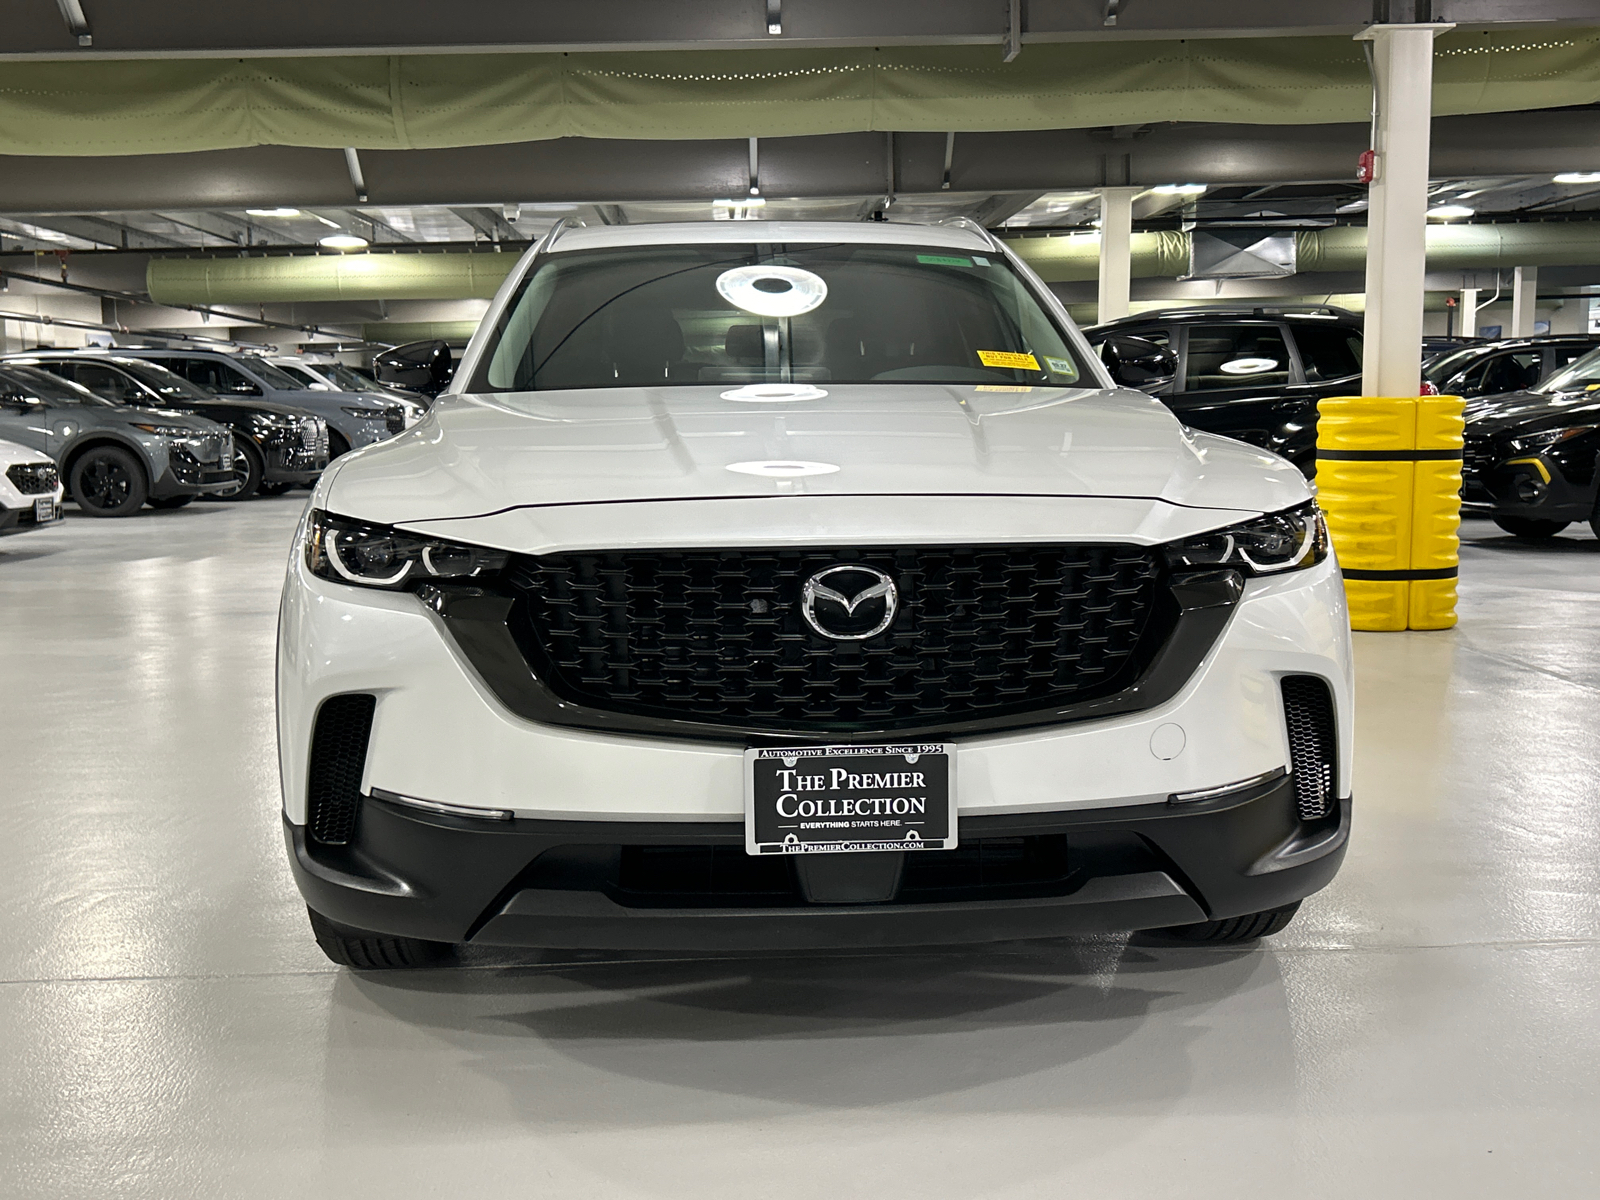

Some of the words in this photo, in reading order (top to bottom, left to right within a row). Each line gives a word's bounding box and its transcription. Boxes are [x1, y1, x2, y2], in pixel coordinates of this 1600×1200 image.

[760, 749, 823, 758] AUTOMOTIVE
[825, 747, 883, 756] EXCELLENCE
[885, 746, 914, 754] SINCE
[916, 745, 942, 753] 1995
[776, 769, 826, 791] THE
[829, 768, 926, 790] PREMIER
[775, 793, 927, 818] COLLECTION
[851, 820, 880, 828] STARTS
[780, 842, 924, 853] THEPREMIERCOLLECTION.COM
